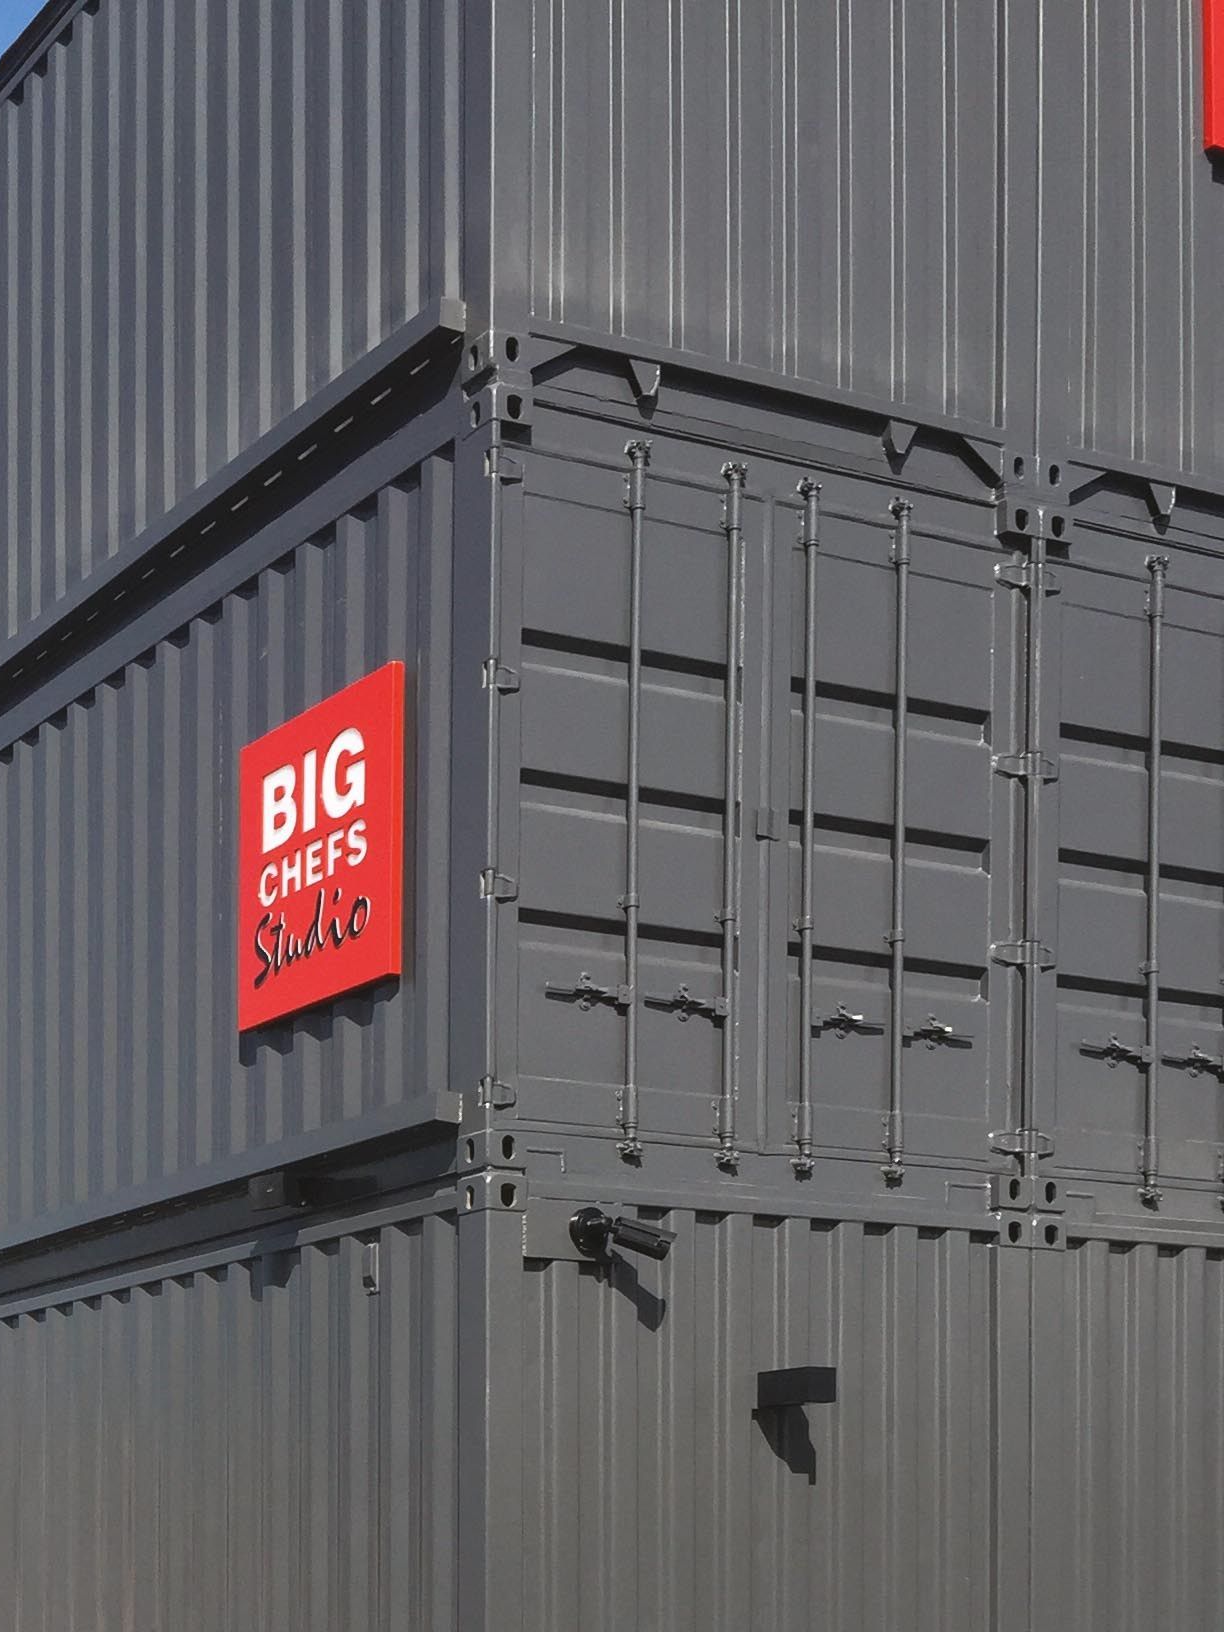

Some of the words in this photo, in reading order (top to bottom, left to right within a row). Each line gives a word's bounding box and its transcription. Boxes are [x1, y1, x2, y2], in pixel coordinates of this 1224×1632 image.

[261, 727, 366, 853] BIG
[257, 818, 367, 908] CHEFS
[254, 887, 370, 989] Studio
